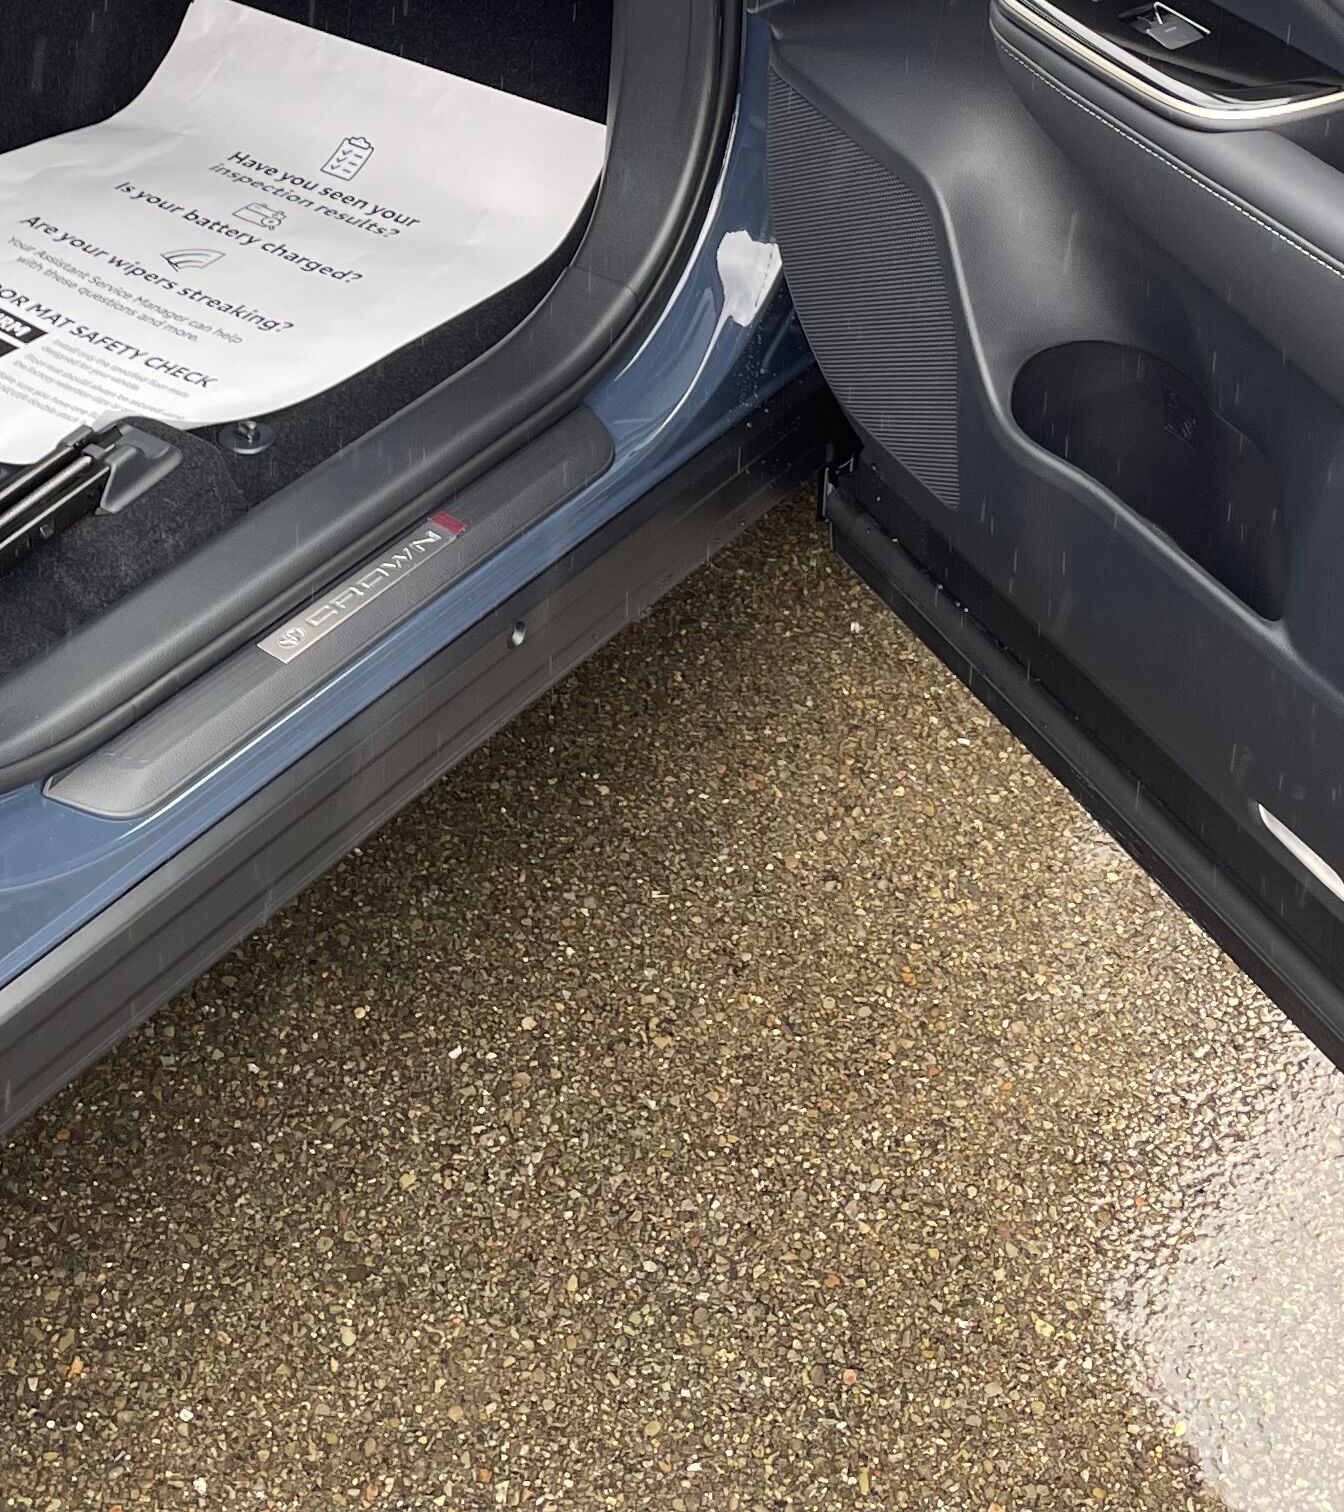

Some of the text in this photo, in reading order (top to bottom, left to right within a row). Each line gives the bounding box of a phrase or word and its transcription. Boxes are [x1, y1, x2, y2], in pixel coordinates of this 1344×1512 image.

[114, 181, 364, 284] Is your battery charged?
[209, 162, 401, 238] inspection results?
[227, 151, 422, 227] Have you seen your
[8, 236, 244, 346] Your Assistant Service Manager can help
[16, 255, 44, 273] with
[43, 268, 78, 289] these
[78, 286, 136, 318] questions
[136, 312, 166, 329] and
[19, 216, 295, 333] Are your wipers streaking?
[25, 303, 76, 328] MAT
[69, 325, 148, 360] SAFETY
[144, 355, 219, 388] CHECK
[305, 530, 442, 627] CROWN
